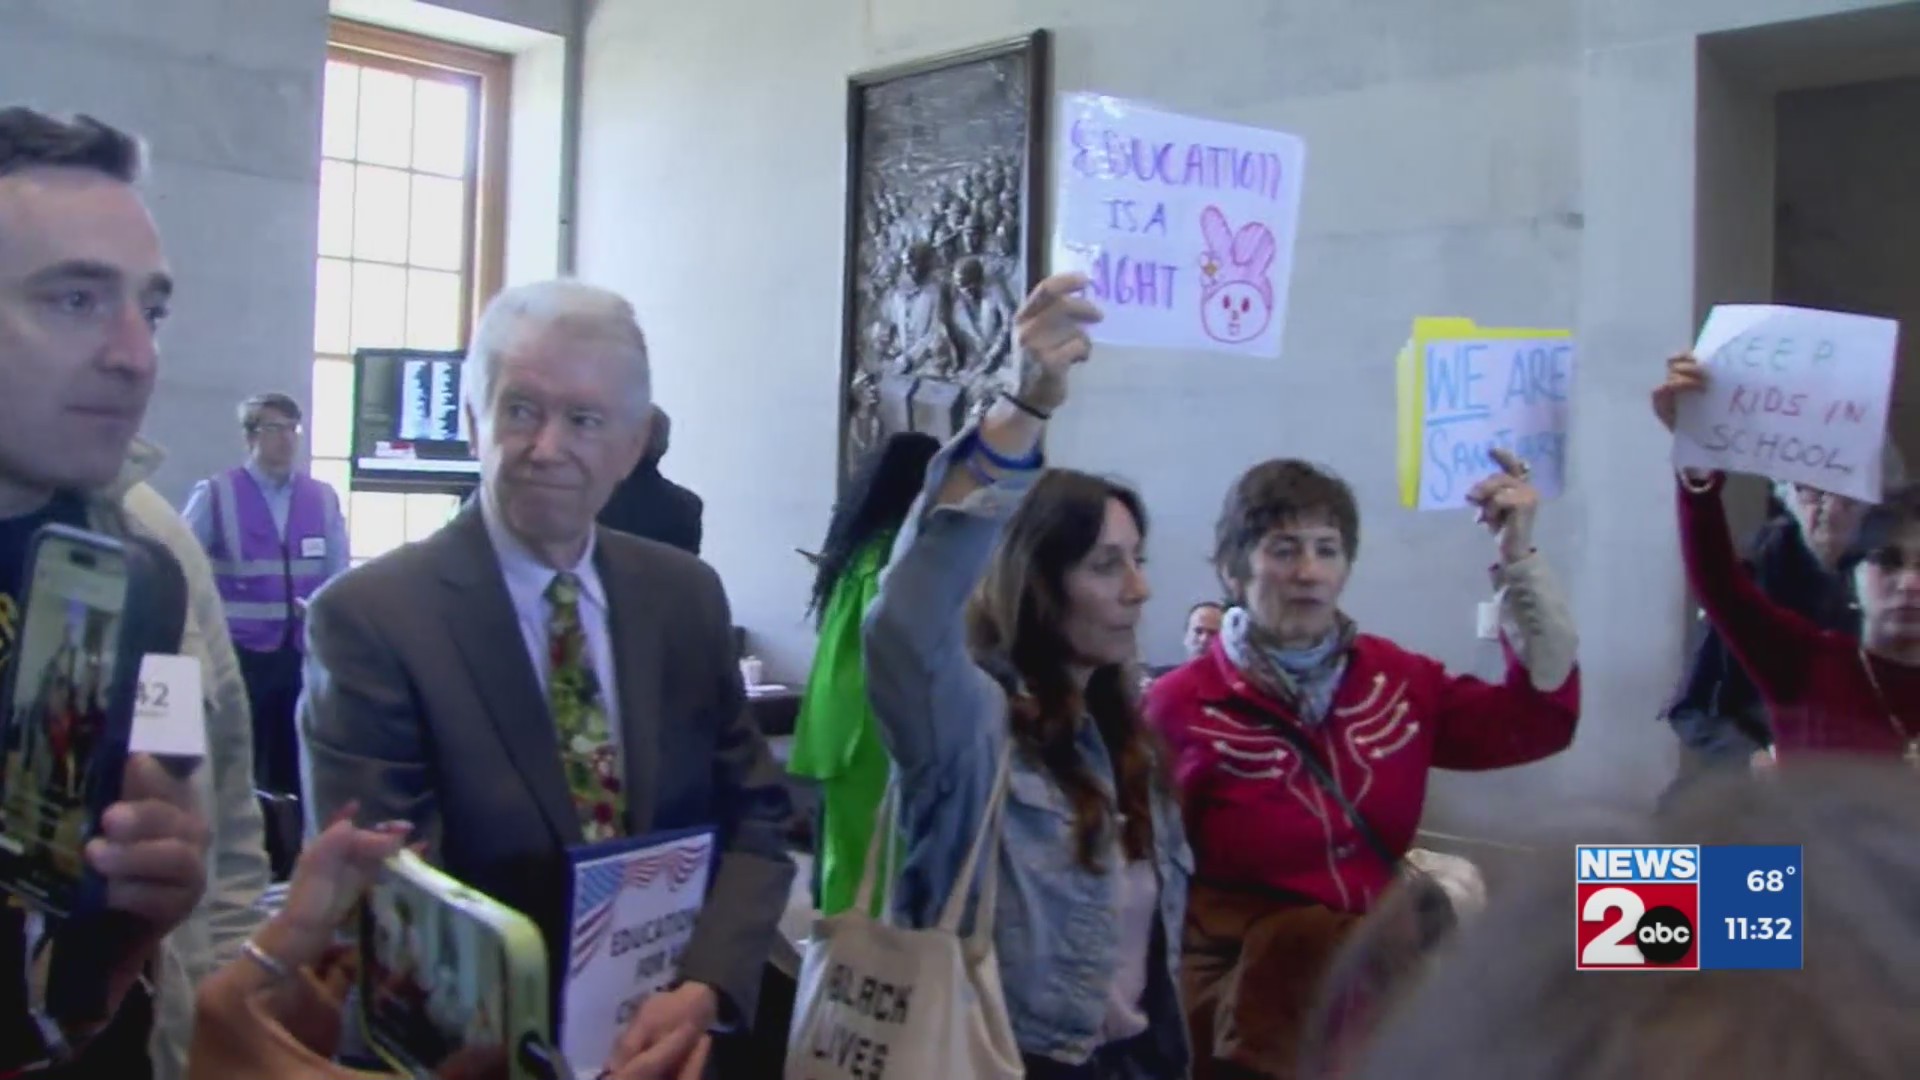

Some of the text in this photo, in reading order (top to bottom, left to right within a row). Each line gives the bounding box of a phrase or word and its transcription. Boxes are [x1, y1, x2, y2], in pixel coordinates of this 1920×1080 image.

[1102, 199, 1167, 235] IS A
[1426, 344, 1571, 412] WE ARE
[1728, 384, 1867, 426] KIDS IN
[1703, 424, 1854, 474] SCHOOL
[829, 963, 914, 1025] BLACK
[812, 1019, 890, 1080] LIVES
